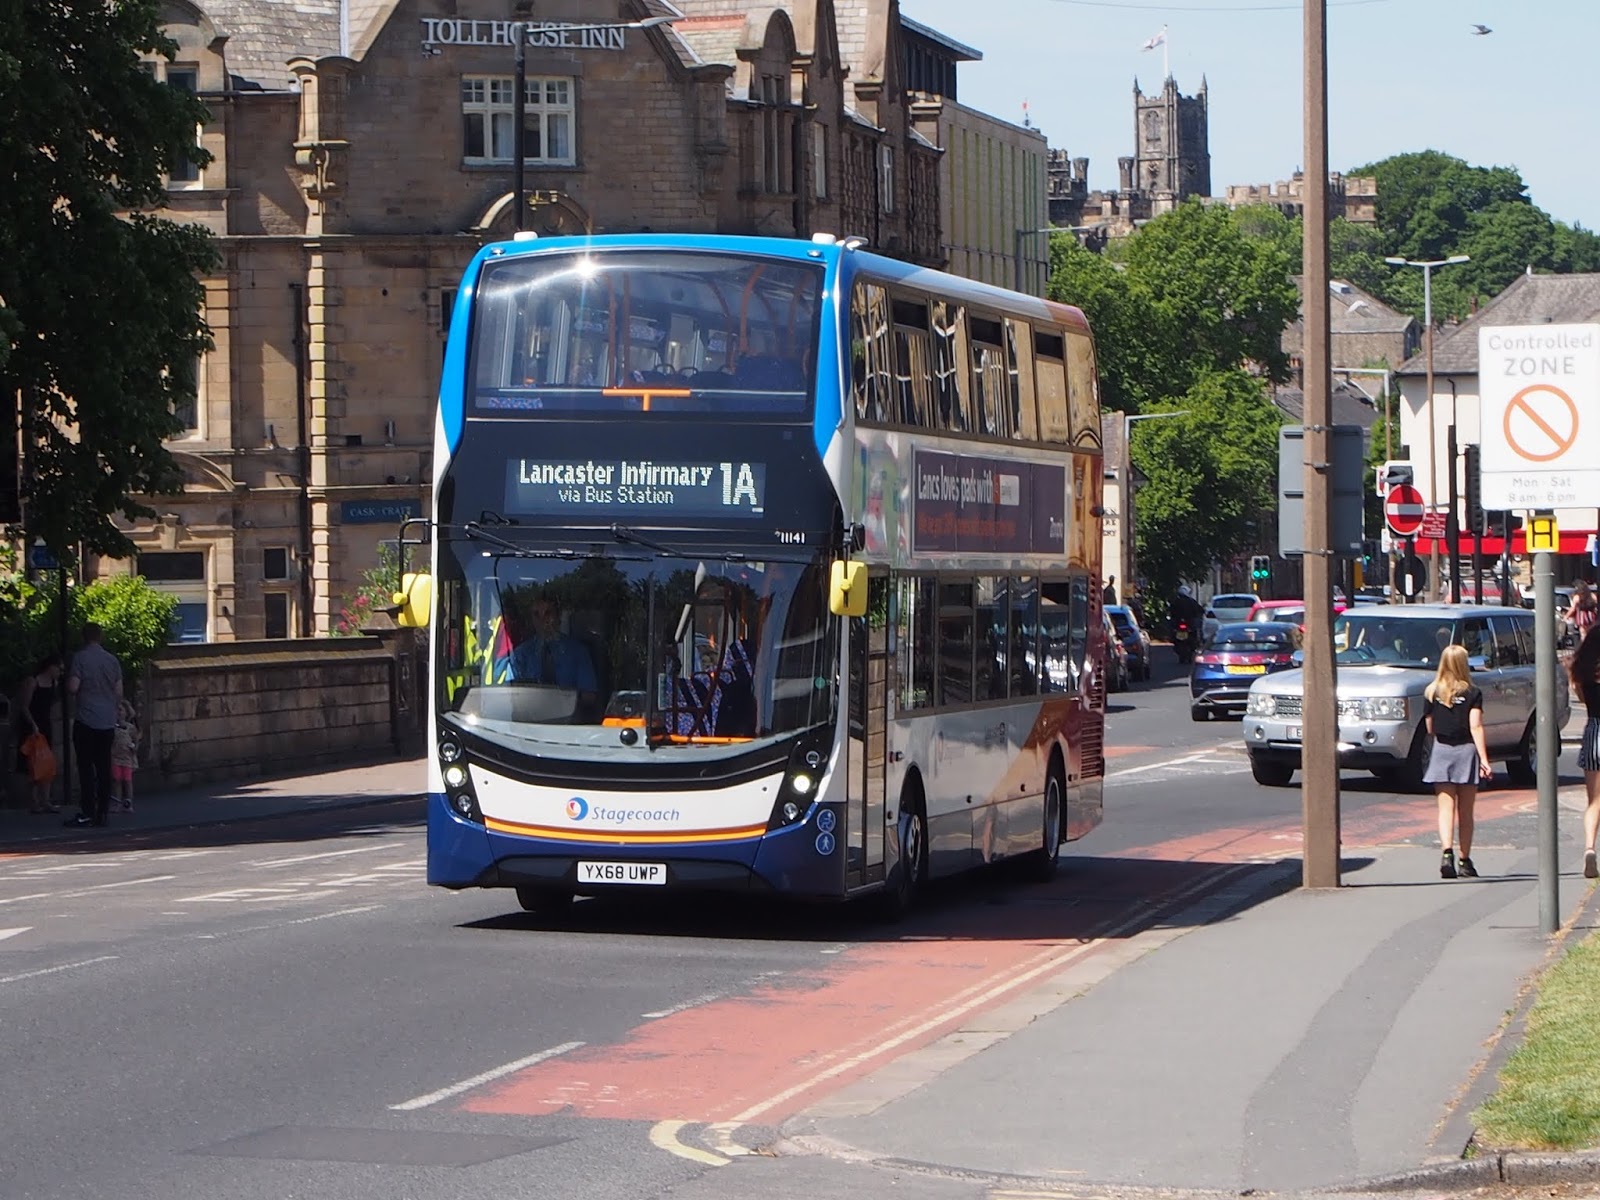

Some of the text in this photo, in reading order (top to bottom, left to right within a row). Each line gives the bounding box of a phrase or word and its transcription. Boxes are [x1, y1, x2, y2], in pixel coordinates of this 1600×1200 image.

[420, 18, 487, 44] TOLL
[581, 24, 625, 49] INN
[1488, 332, 1592, 351] Controlled
[1503, 356, 1576, 376] ZONE
[519, 459, 758, 505] Lancaster Infirmary 1A
[918, 463, 940, 500] Lancs
[941, 464, 960, 502] loves
[976, 469, 994, 504] with
[1512, 476, 1573, 488] Mon Sat
[558, 485, 675, 504] via Bus Station
[349, 507, 375, 517] CASK
[1531, 518, 1553, 548] H
[591, 806, 680, 825] Stagecoach
[585, 864, 659, 881] YX68 UWP
